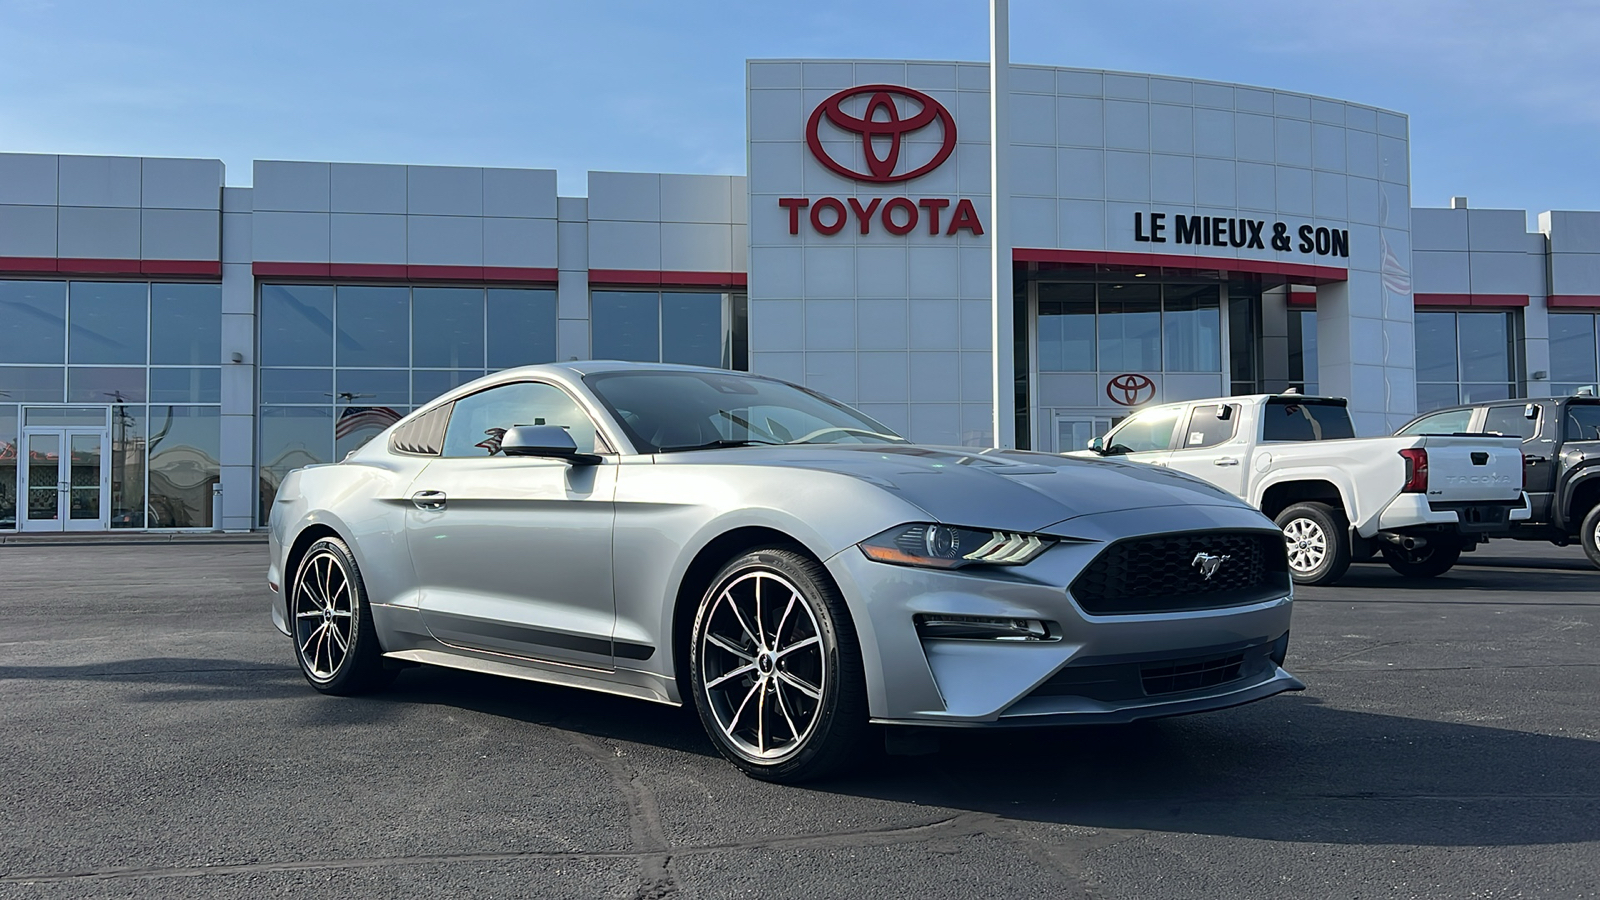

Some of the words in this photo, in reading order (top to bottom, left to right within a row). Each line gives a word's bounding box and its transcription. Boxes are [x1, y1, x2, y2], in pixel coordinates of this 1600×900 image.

[779, 197, 984, 236] TOYOTA
[1135, 211, 1166, 243] LE
[1175, 214, 1265, 250] MIEUX
[1272, 221, 1292, 252] &
[1299, 224, 1349, 258] SON
[1445, 475, 1511, 484] TACOMA
